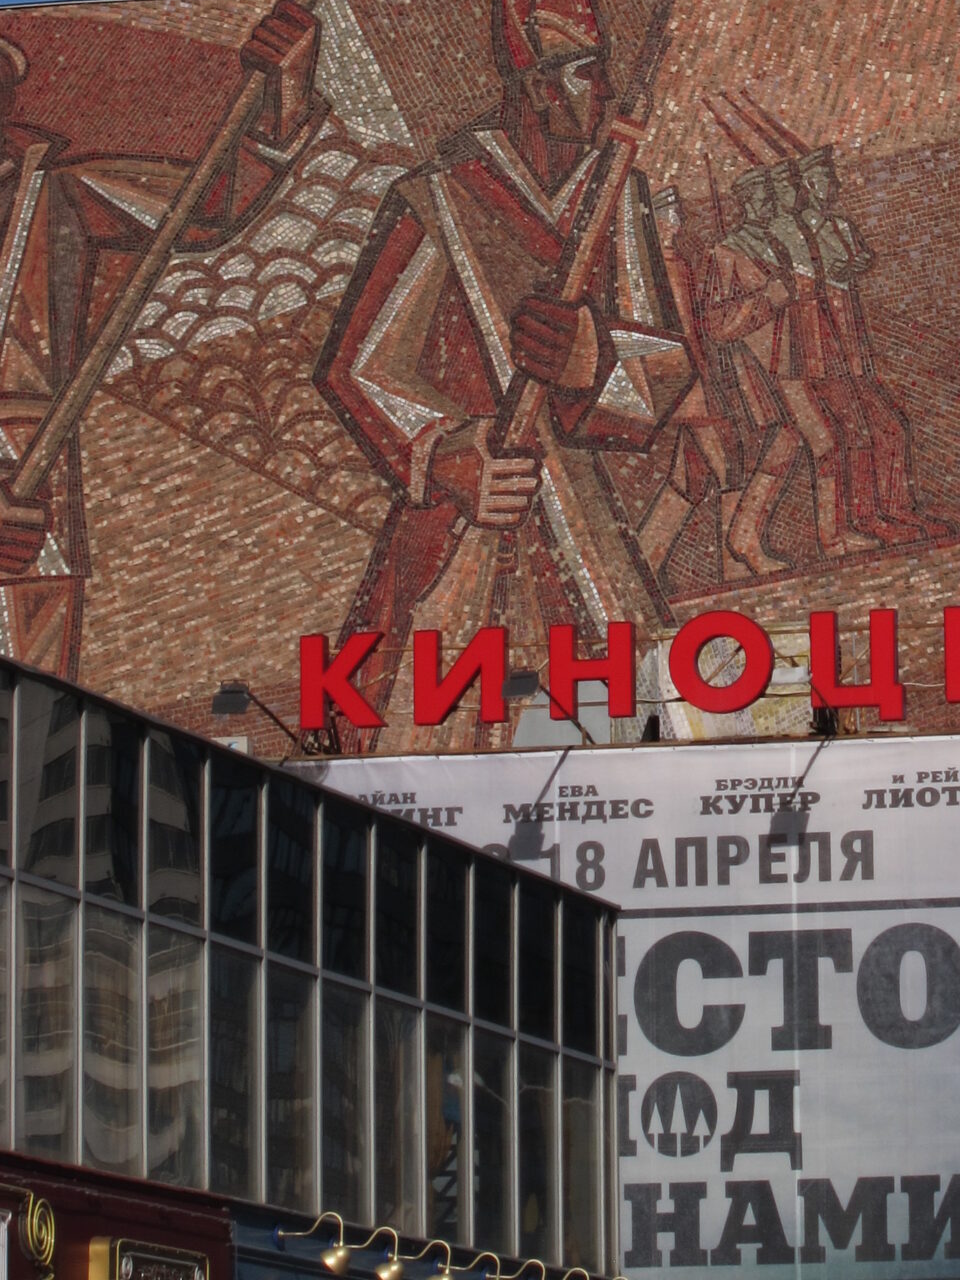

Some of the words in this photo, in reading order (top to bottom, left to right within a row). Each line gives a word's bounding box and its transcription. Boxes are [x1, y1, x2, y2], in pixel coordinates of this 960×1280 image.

[715, 775, 805, 792] БРЭДЛИ
[916, 767, 960, 784] РЕЙ
[558, 784, 599, 798] ЕВА
[502, 798, 655, 824] МЕНДЕС
[699, 791, 821, 816] КУПЕР
[632, 829, 875, 889] АПРЕЛЯ
